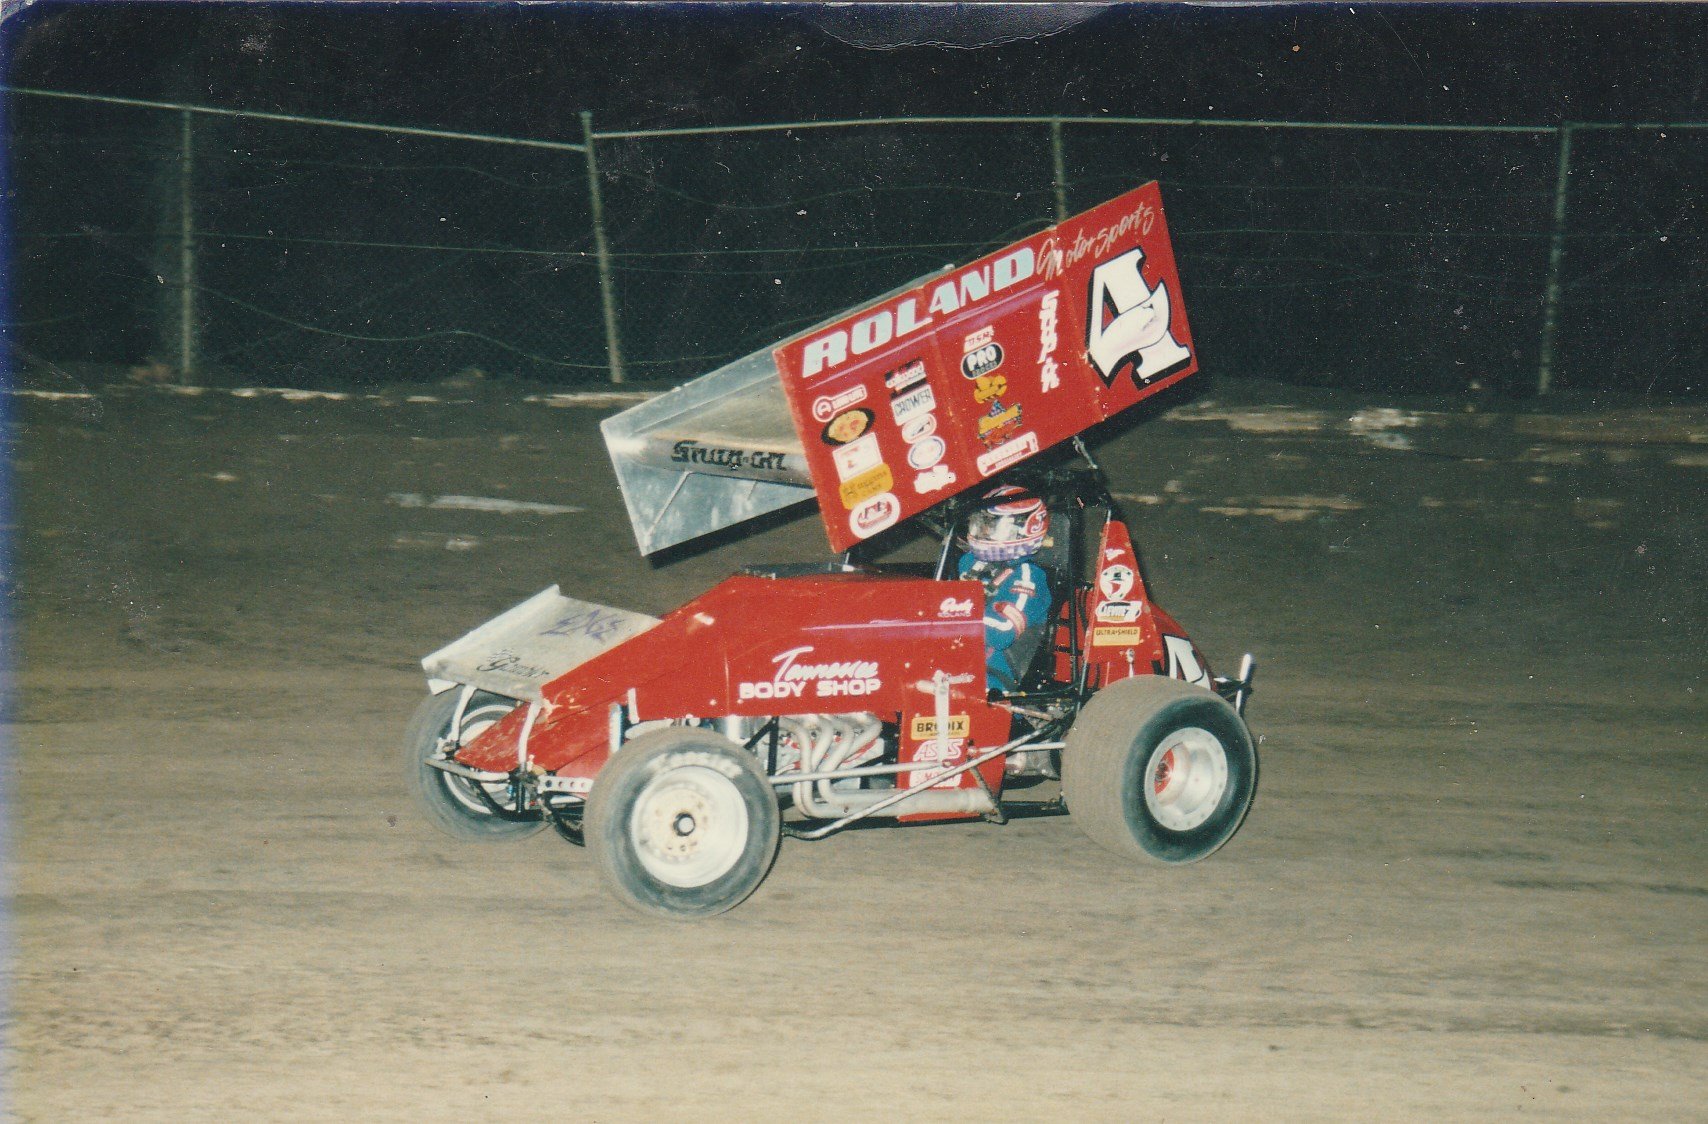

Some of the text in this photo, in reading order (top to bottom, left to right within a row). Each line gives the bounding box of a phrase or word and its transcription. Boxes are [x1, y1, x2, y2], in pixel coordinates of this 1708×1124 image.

[802, 201, 1155, 378] ROLAND Motorsports
[1087, 246, 1191, 390] 4
[966, 345, 998, 372] PRO
[894, 388, 932, 417] CROWER
[738, 678, 882, 699] BODY SHOP
[916, 720, 964, 733] BRIX
